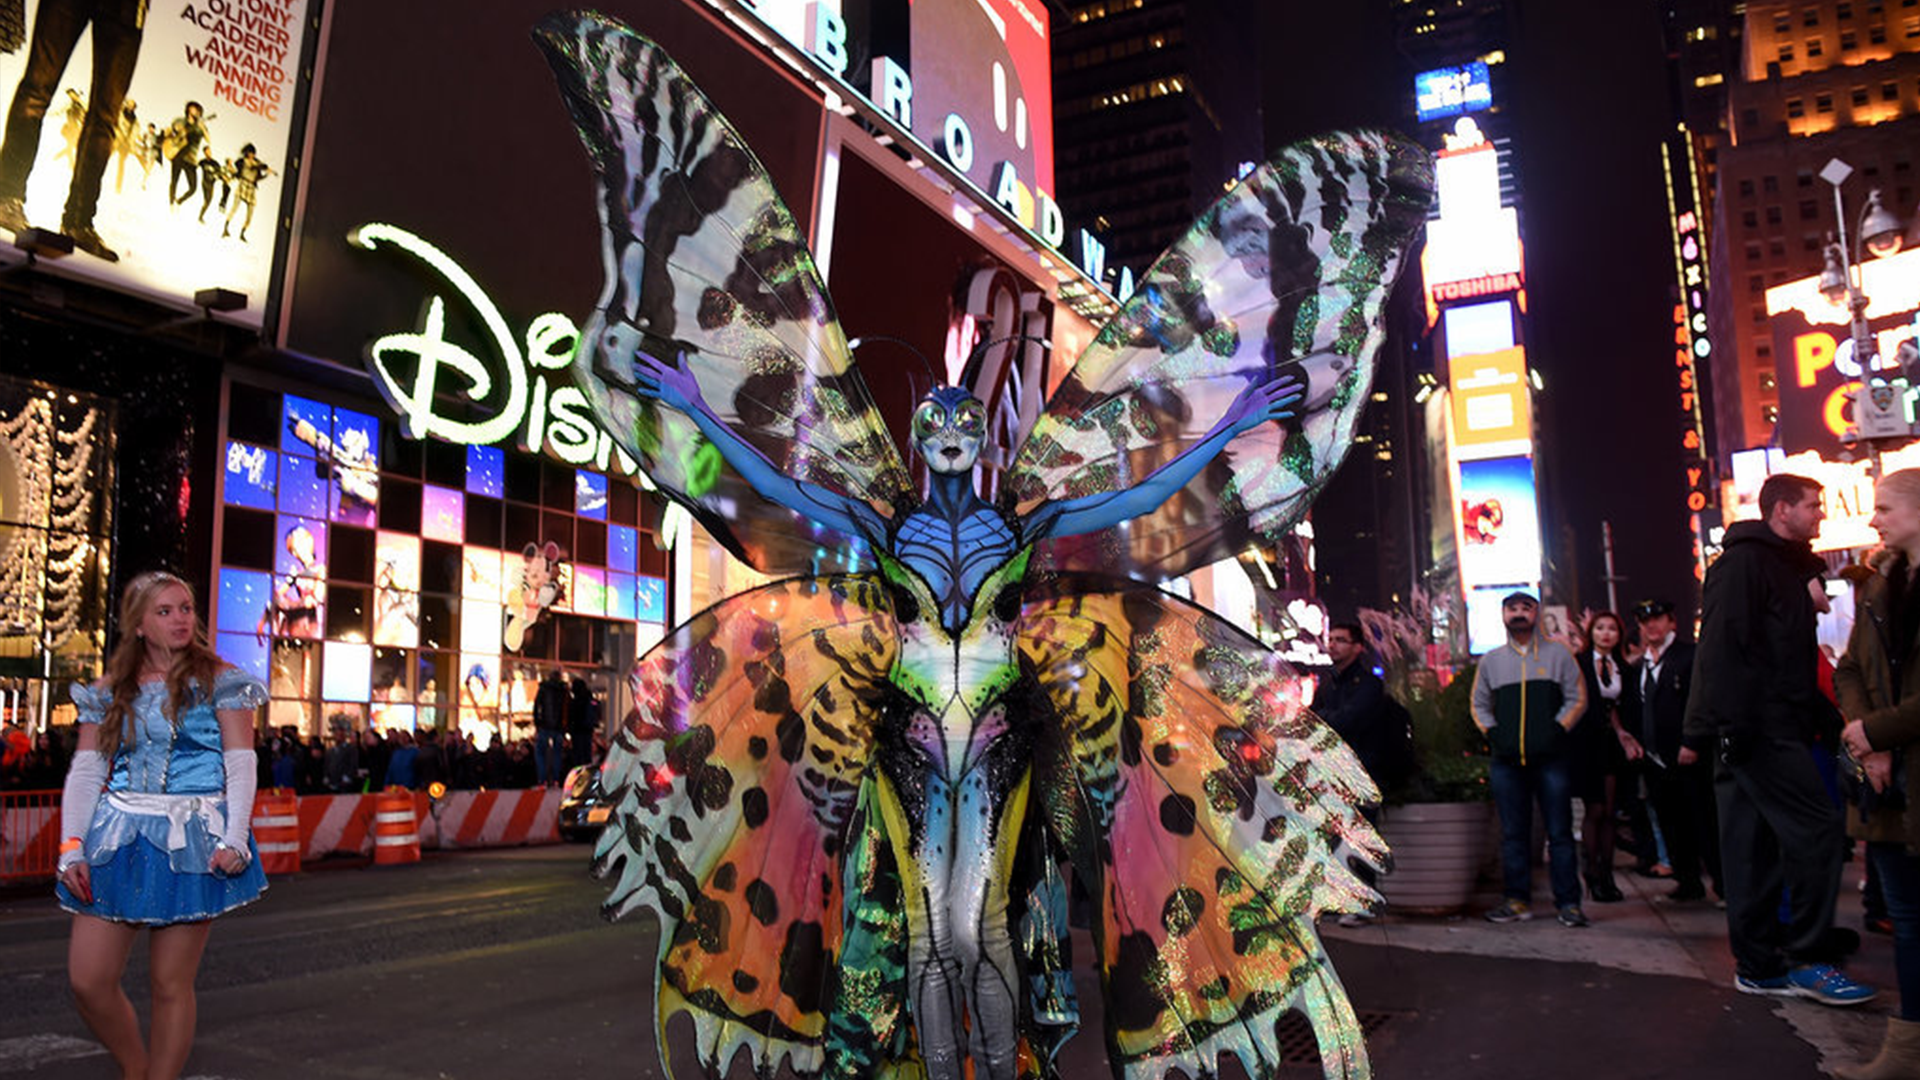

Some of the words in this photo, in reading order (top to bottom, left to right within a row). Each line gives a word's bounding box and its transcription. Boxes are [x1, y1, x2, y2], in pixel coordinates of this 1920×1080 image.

[181, 4, 288, 64] ACADEMY
[208, 0, 290, 48] OLIVIER
[238, 0, 292, 27] ONY
[184, 43, 281, 103] WINNING
[214, 80, 279, 122] MUSIC
[1432, 273, 1522, 302] TOSHIBA
[1673, 304, 1694, 411] ERNST
[1683, 429, 1699, 449] &
